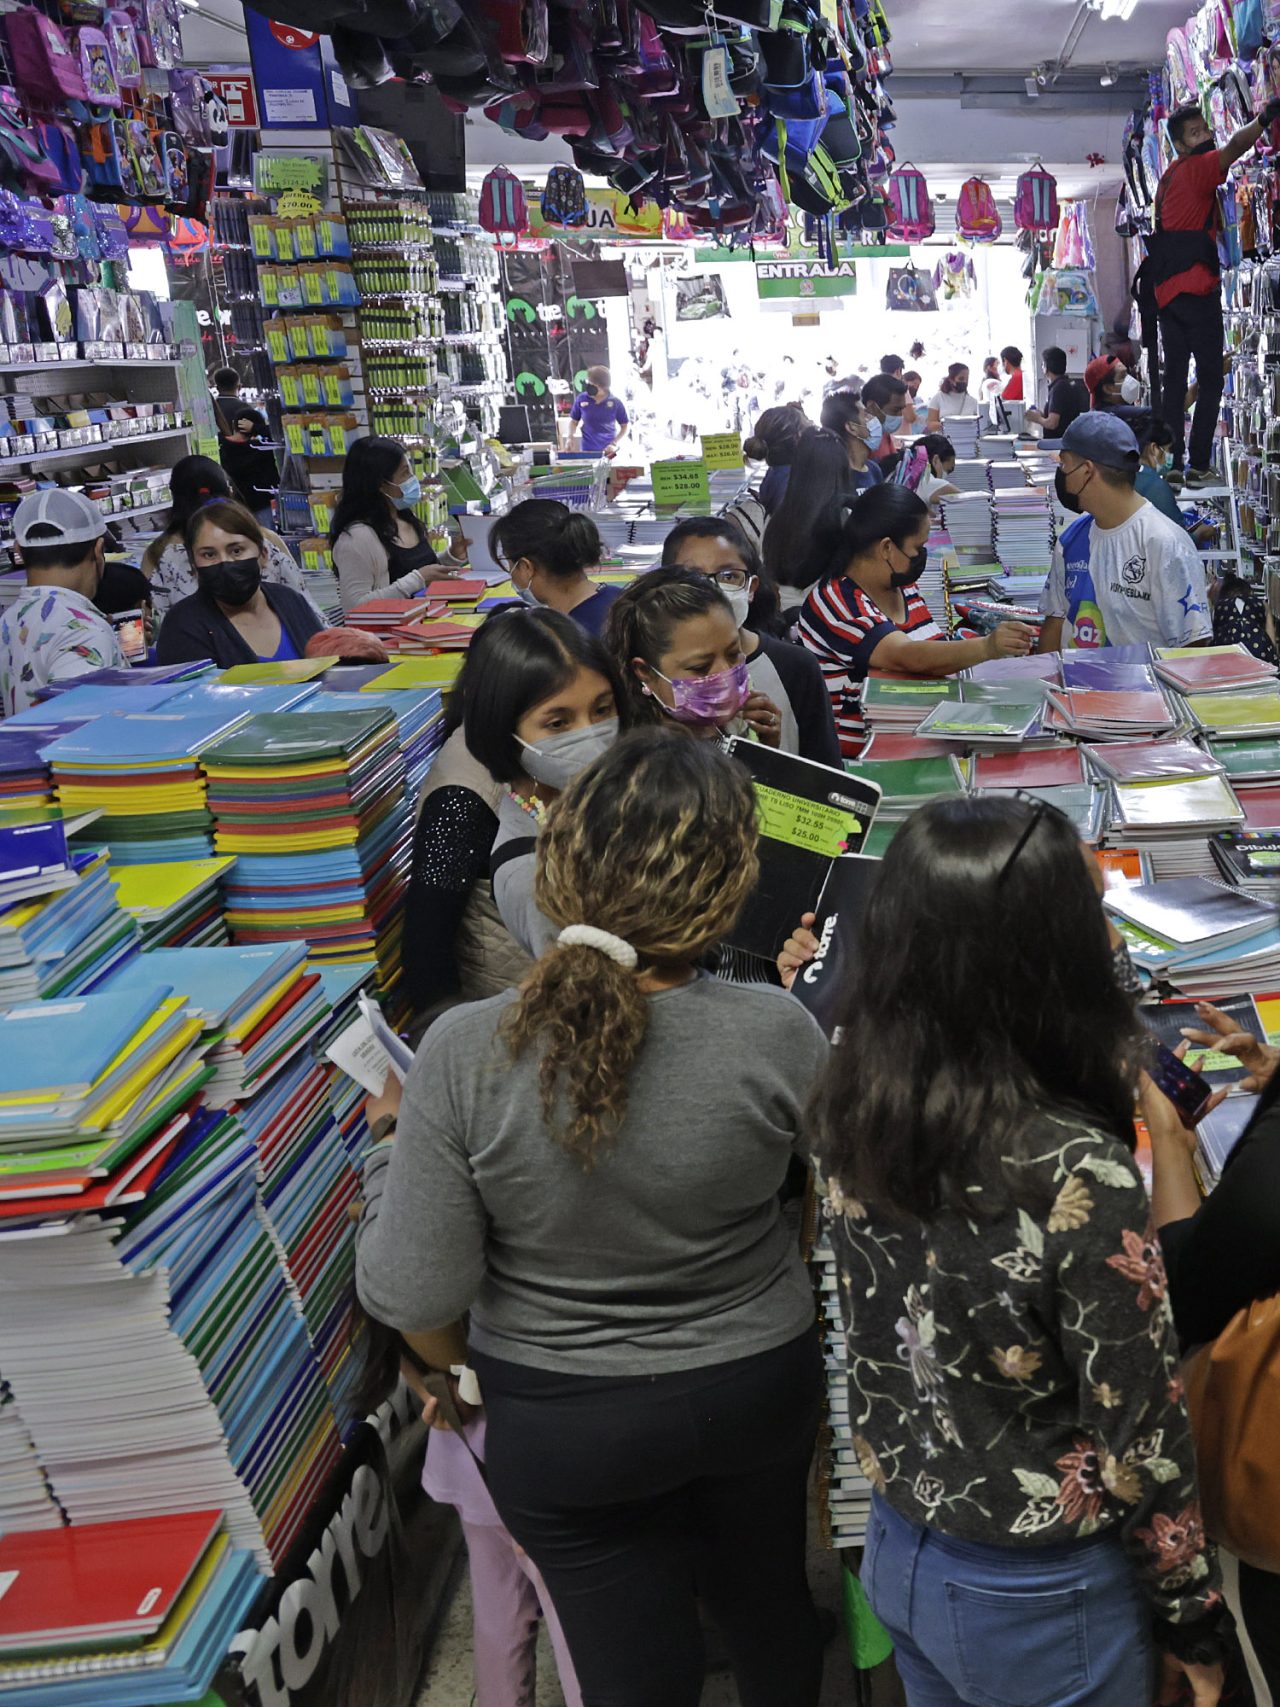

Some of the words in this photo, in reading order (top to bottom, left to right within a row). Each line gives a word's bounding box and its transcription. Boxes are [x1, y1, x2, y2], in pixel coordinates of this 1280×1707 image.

[757, 263, 855, 279] ENTRADA
[795, 814, 824, 830] $32.55
[791, 827, 820, 842] $25.00
[240, 1464, 389, 1707] torre
